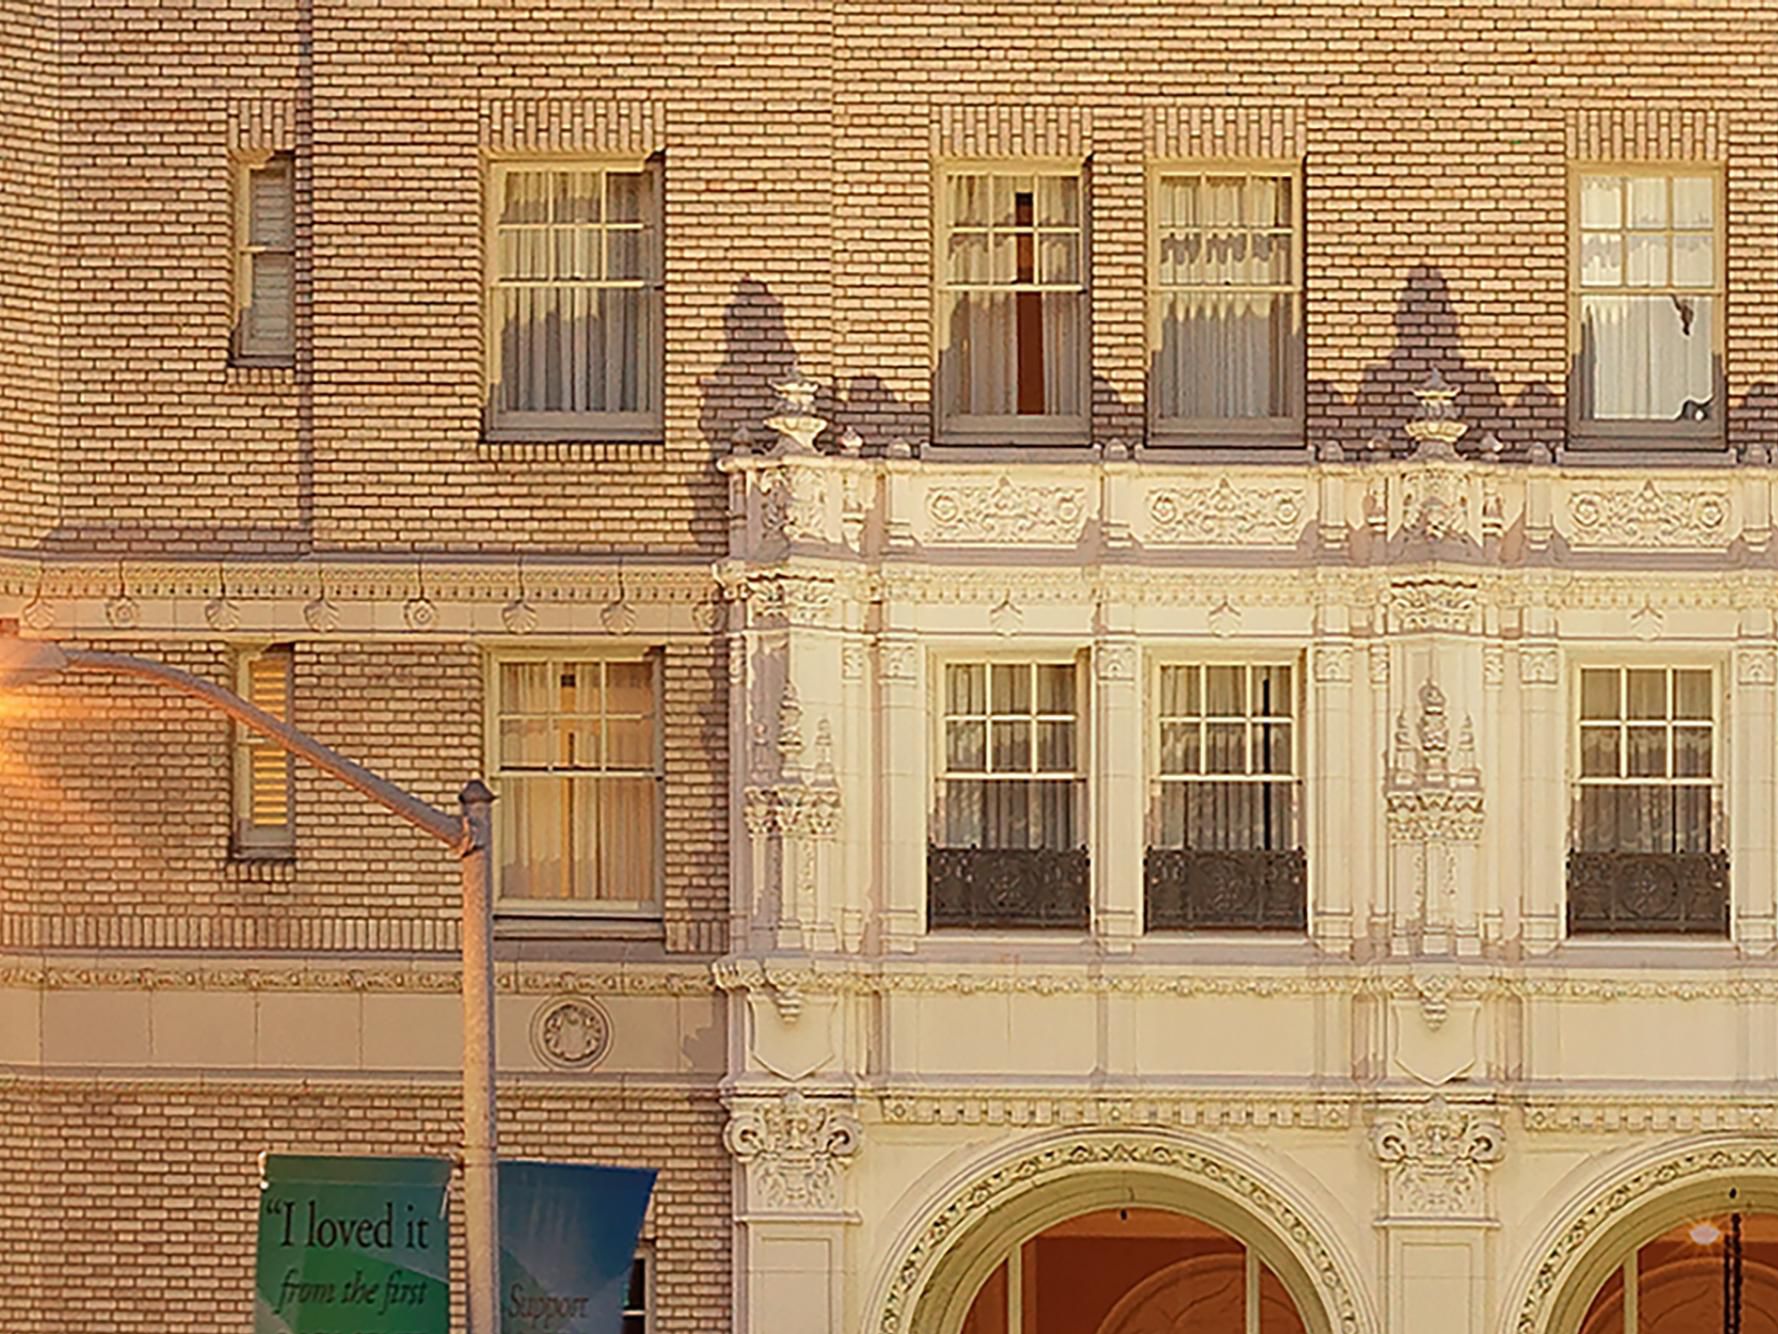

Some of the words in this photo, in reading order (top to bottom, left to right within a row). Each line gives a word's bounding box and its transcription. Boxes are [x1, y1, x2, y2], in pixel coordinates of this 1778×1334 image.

[306, 1200, 393, 1249] loved
[405, 1203, 430, 1249] it
[273, 1267, 336, 1315] from
[342, 1269, 380, 1304] the
[378, 1269, 428, 1316] first
[507, 1283, 590, 1329] Support
